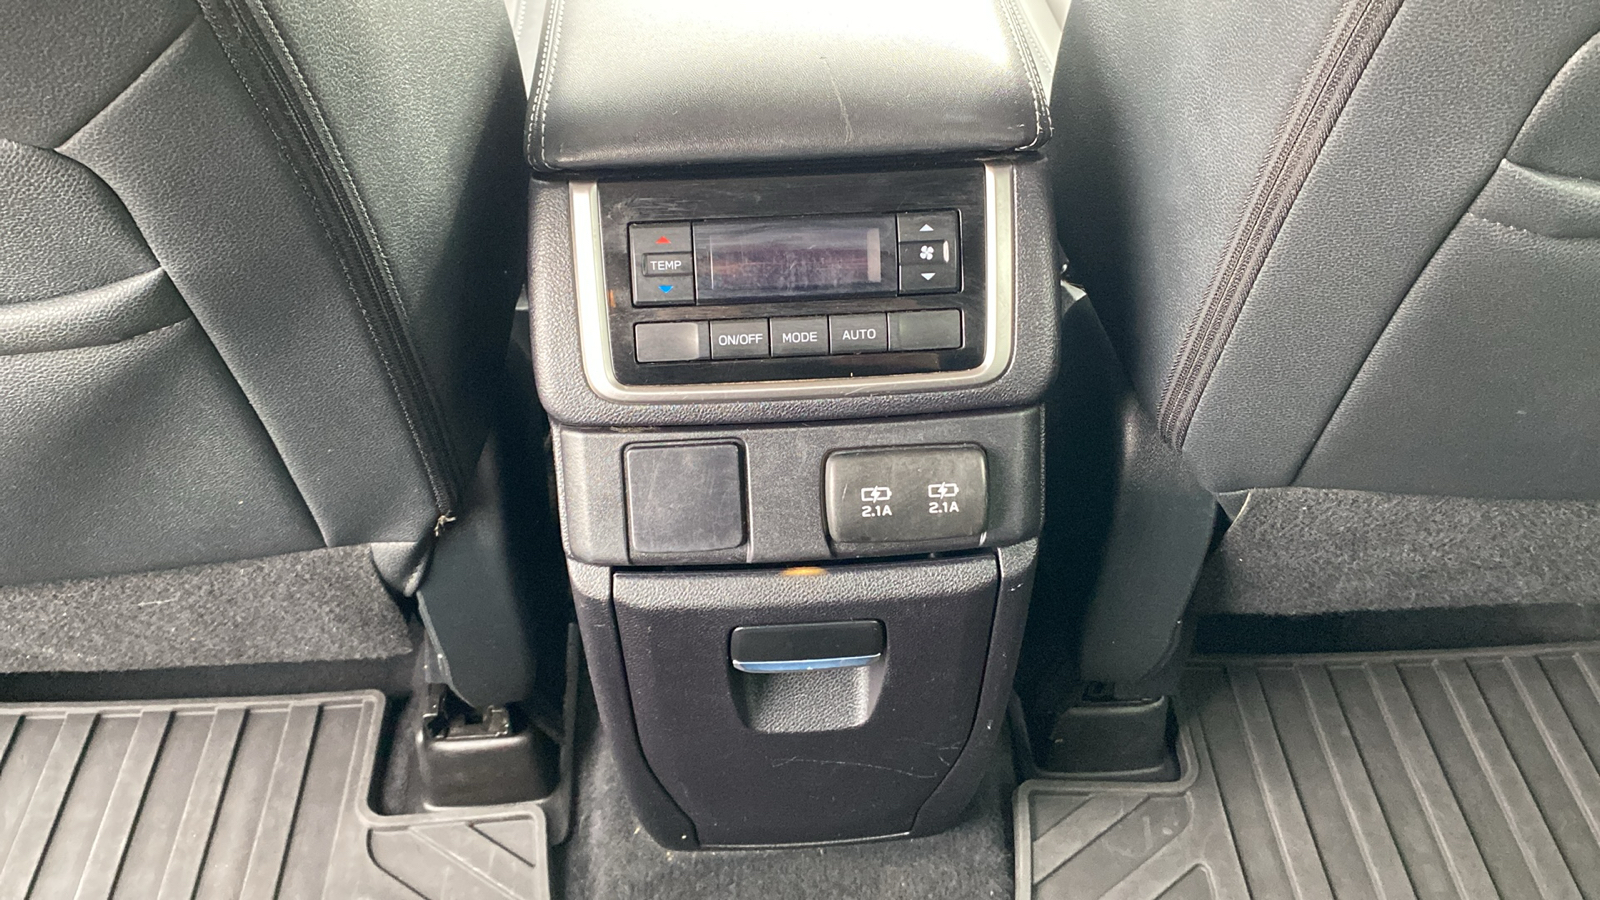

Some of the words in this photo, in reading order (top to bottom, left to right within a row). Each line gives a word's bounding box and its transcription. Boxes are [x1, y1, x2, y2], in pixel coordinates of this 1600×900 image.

[649, 259, 682, 271] TEMP
[718, 333, 763, 346] ON/OFF
[782, 331, 818, 344] MODE
[842, 328, 876, 341] AUTO
[861, 504, 892, 518] 2.1A
[928, 501, 960, 514] 2.1A
